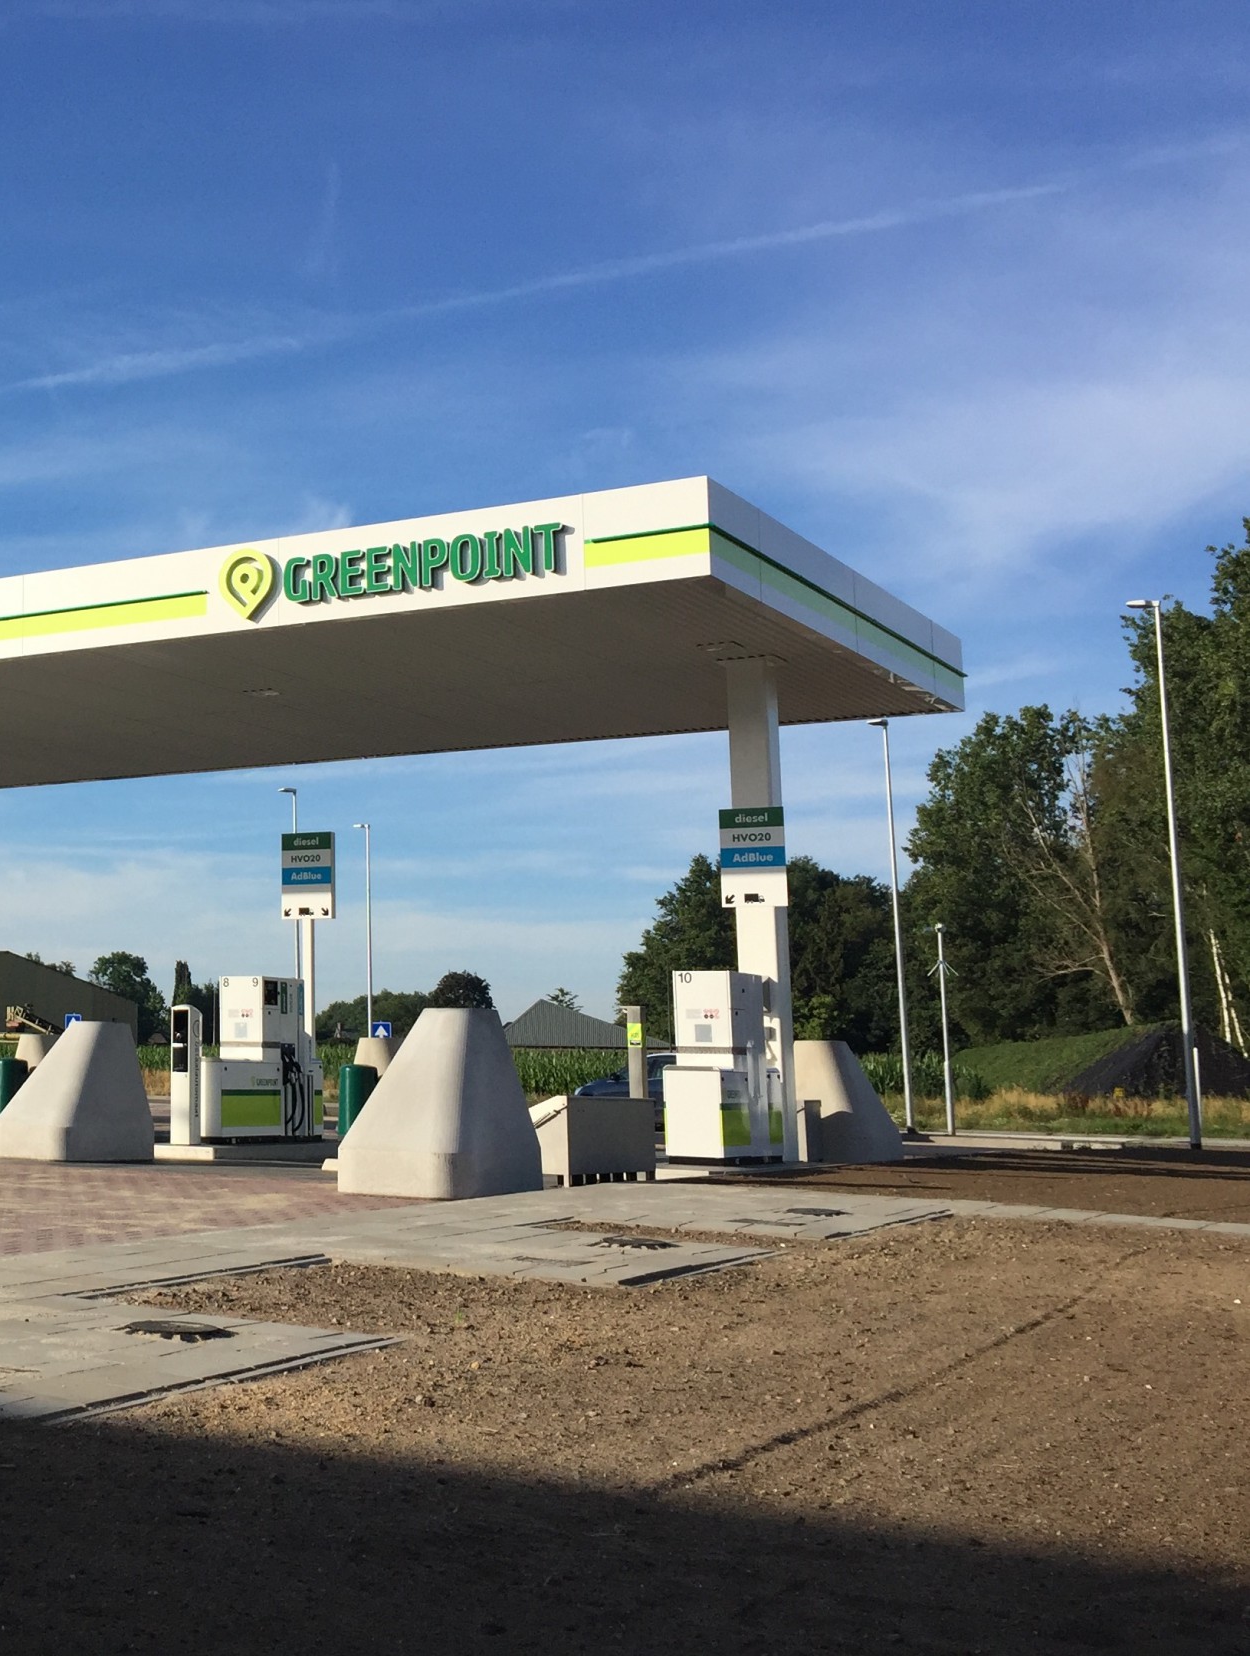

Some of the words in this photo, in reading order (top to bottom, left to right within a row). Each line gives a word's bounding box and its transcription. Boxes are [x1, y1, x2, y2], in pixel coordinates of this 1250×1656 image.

[283, 522, 563, 603] GREENPOINT
[734, 812, 768, 823] diesel
[293, 837, 319, 846] diesel
[732, 832, 772, 842] HVO20
[290, 854, 321, 863] HVO20
[732, 852, 774, 863] AdBlue
[291, 871, 322, 881] AdBlue
[222, 977, 230, 987] 8
[252, 977, 259, 987] 9
[678, 972, 692, 984] 10
